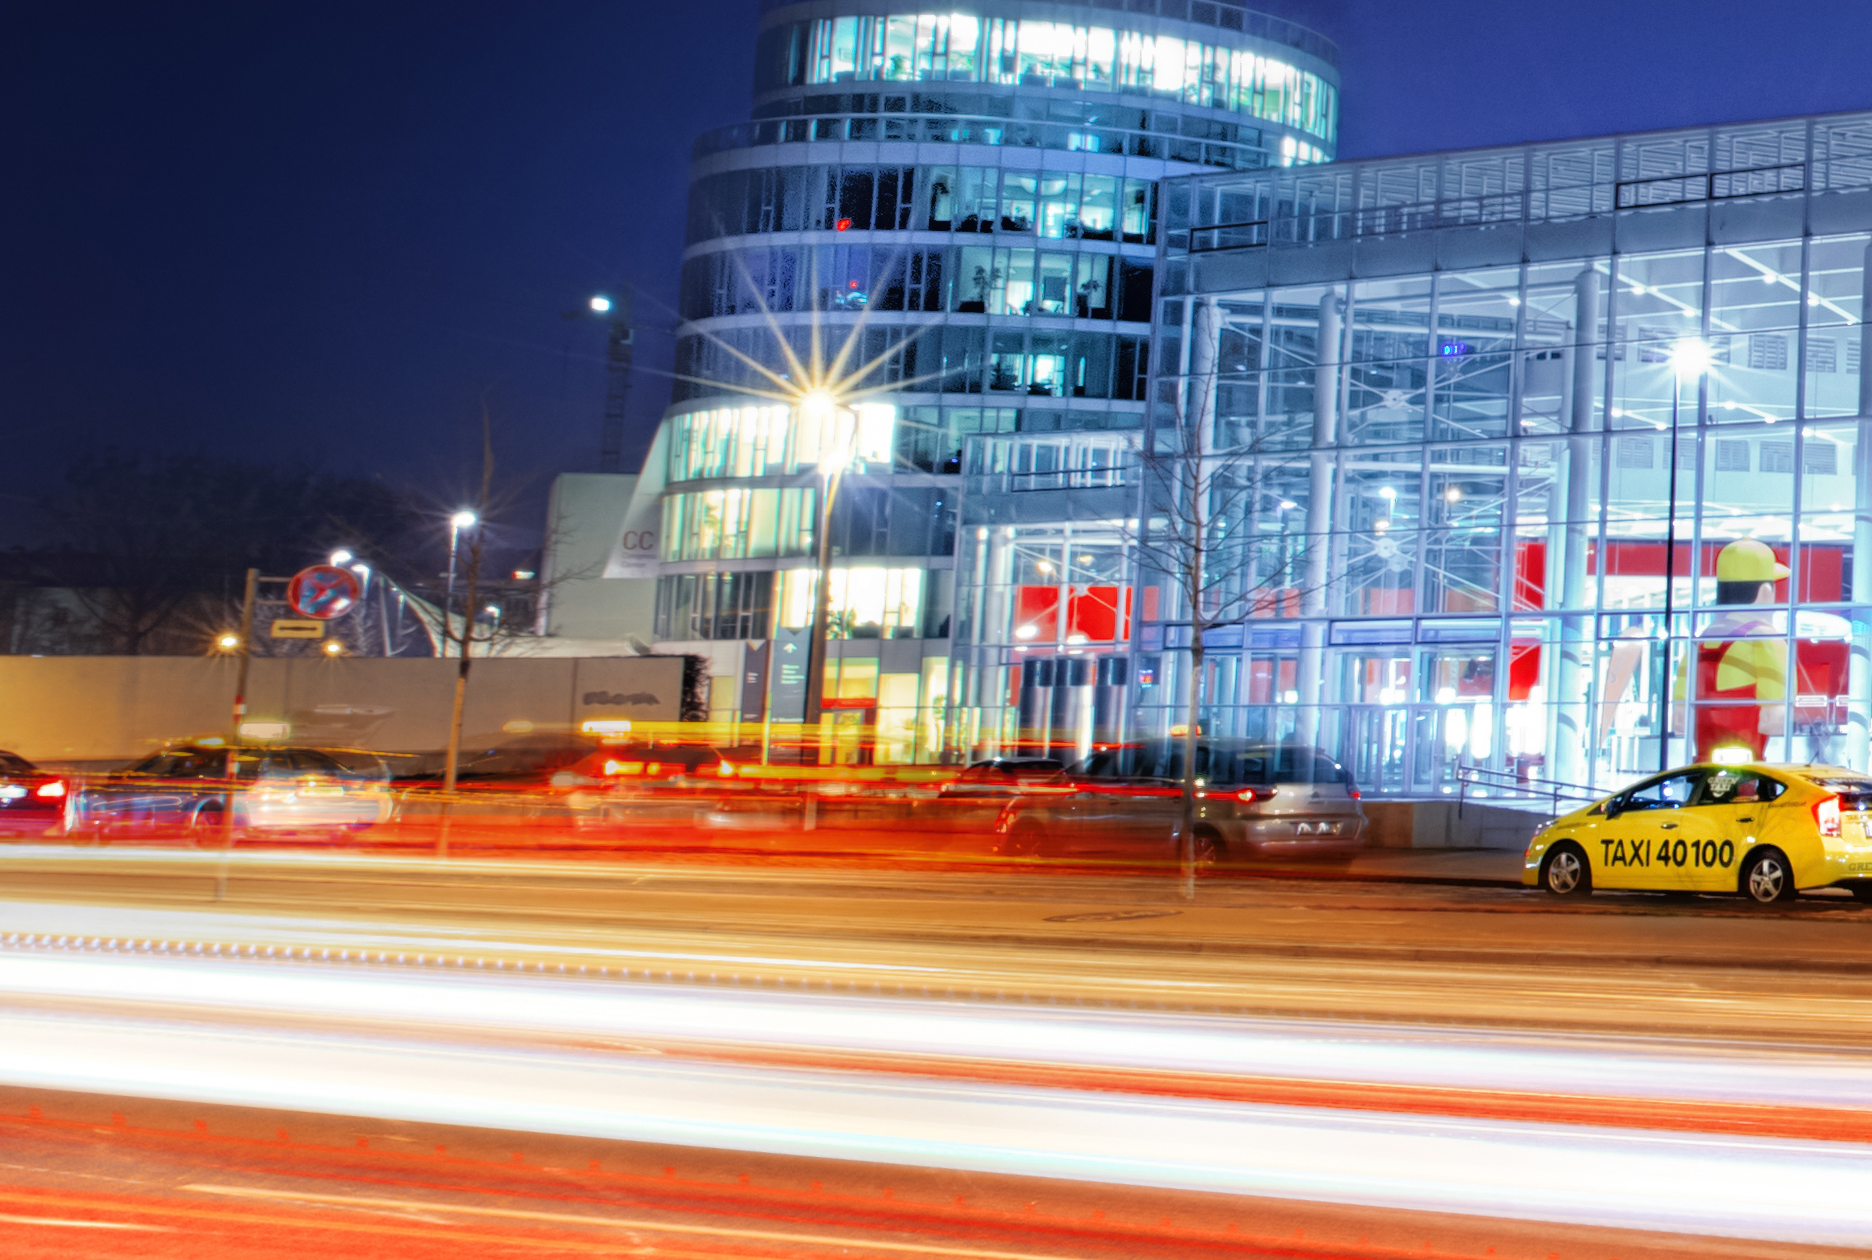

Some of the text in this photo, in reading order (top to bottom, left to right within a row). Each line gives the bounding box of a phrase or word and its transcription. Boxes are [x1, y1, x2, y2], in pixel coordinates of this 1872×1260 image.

[623, 530, 654, 550] CC
[1600, 839, 1735, 868] TAXI 40100
